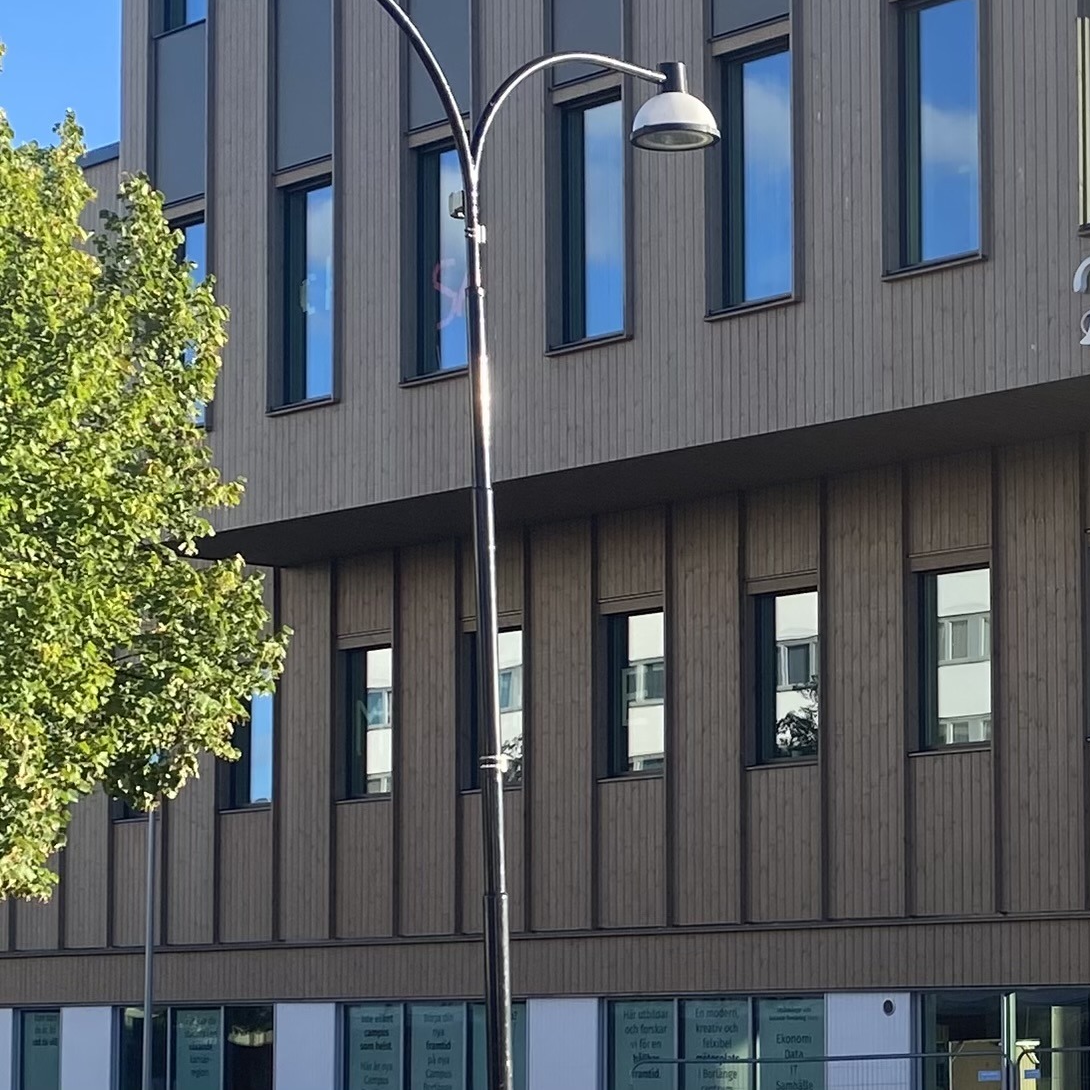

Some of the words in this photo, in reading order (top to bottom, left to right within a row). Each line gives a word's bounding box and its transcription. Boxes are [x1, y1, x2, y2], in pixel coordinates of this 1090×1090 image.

[623, 1009, 636, 1020] Här
[637, 1008, 668, 1020] utbildar
[695, 1008, 705, 1018] En
[706, 1008, 739, 1019] modern,
[432, 1028, 445, 1038] nya
[624, 1023, 639, 1034] och
[640, 1023, 667, 1034] forskar
[695, 1022, 722, 1033] kreativ
[723, 1022, 738, 1033] och
[364, 1029, 389, 1038] campus
[776, 1033, 812, 1044] Ekonomi
[360, 1042, 374, 1051] som
[425, 1040, 452, 1051] framtid
[639, 1038, 650, 1049] för
[651, 1040, 662, 1049] en
[427, 1053, 436, 1066] på
[437, 1056, 450, 1067] nya
[784, 1049, 804, 1060] Data
[382, 1062, 393, 1074] nya
[425, 1068, 453, 1079] Campus
[790, 1064, 798, 1076] IT
[702, 1067, 738, 1081] Borlänge
[363, 1075, 390, 1086] Campus
